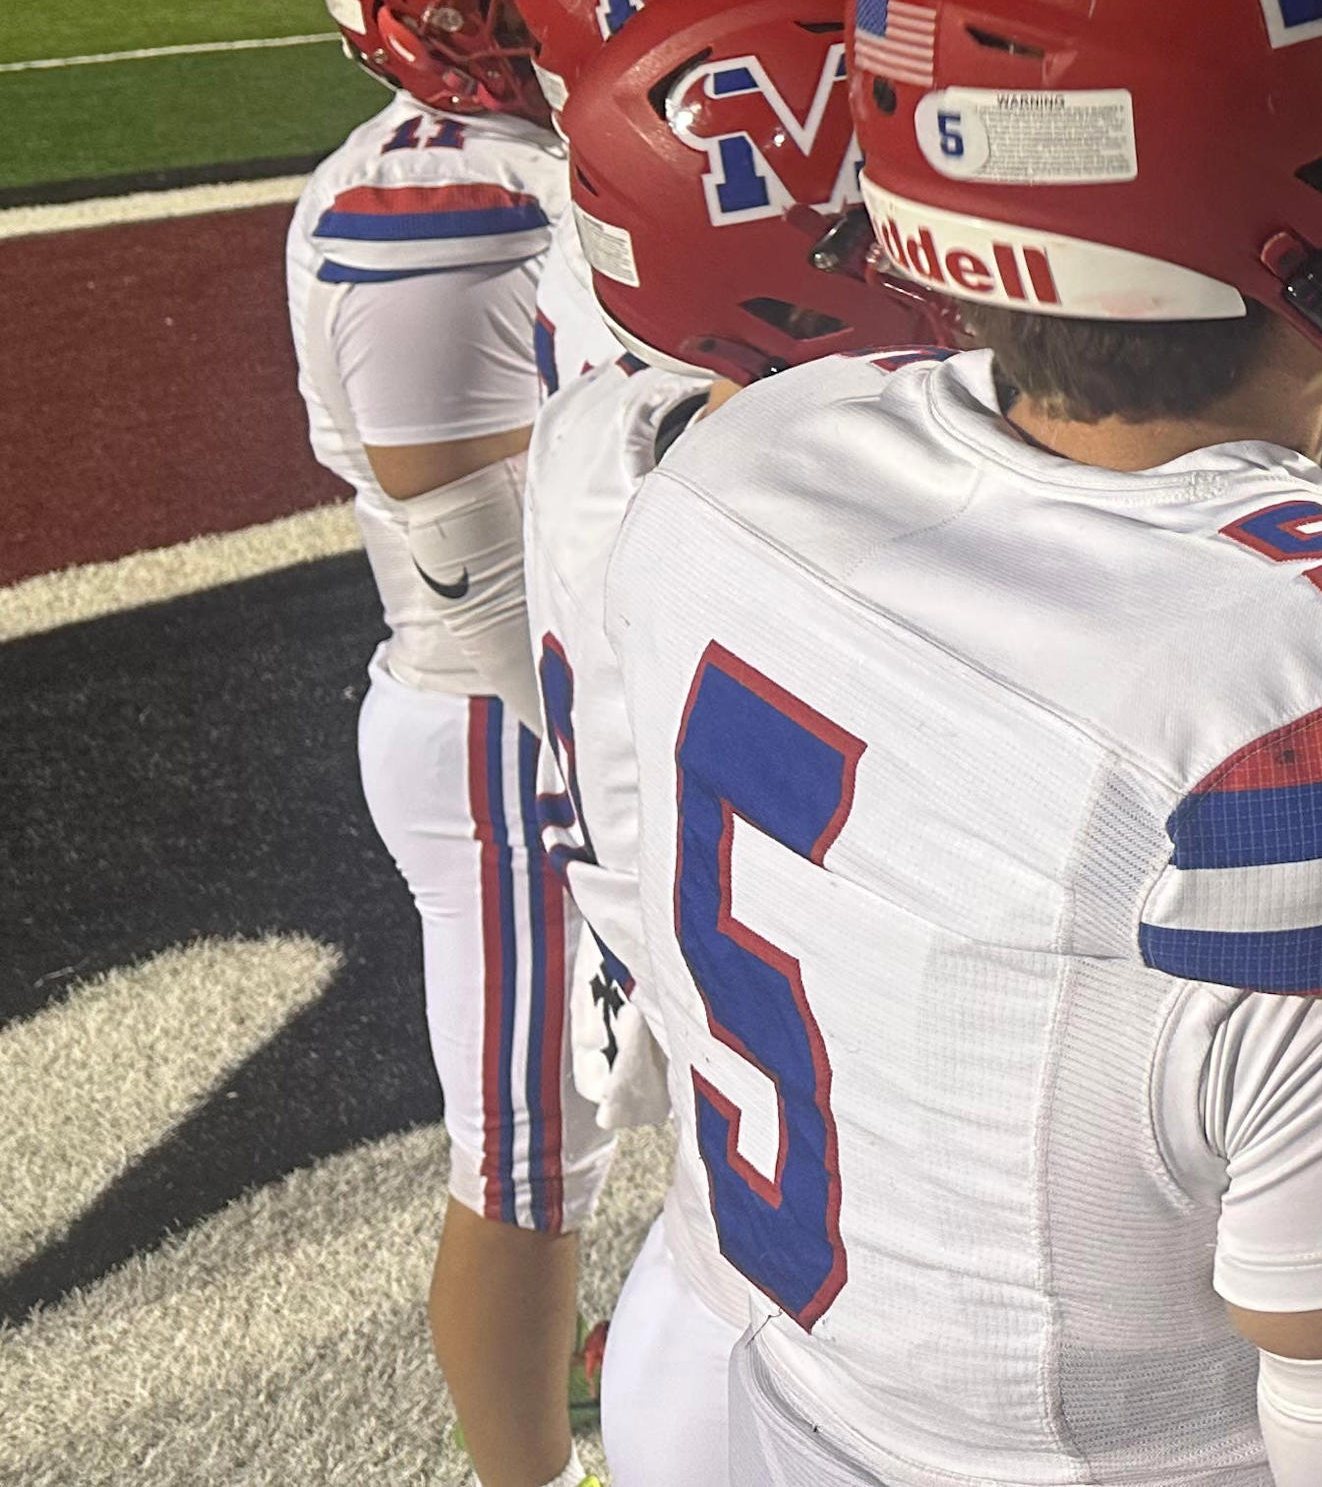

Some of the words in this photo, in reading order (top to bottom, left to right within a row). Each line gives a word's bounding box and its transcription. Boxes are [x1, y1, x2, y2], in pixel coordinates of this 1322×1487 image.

[996, 93, 1066, 111] WARNING
[379, 115, 472, 156] 11
[672, 638, 869, 1335] 5
